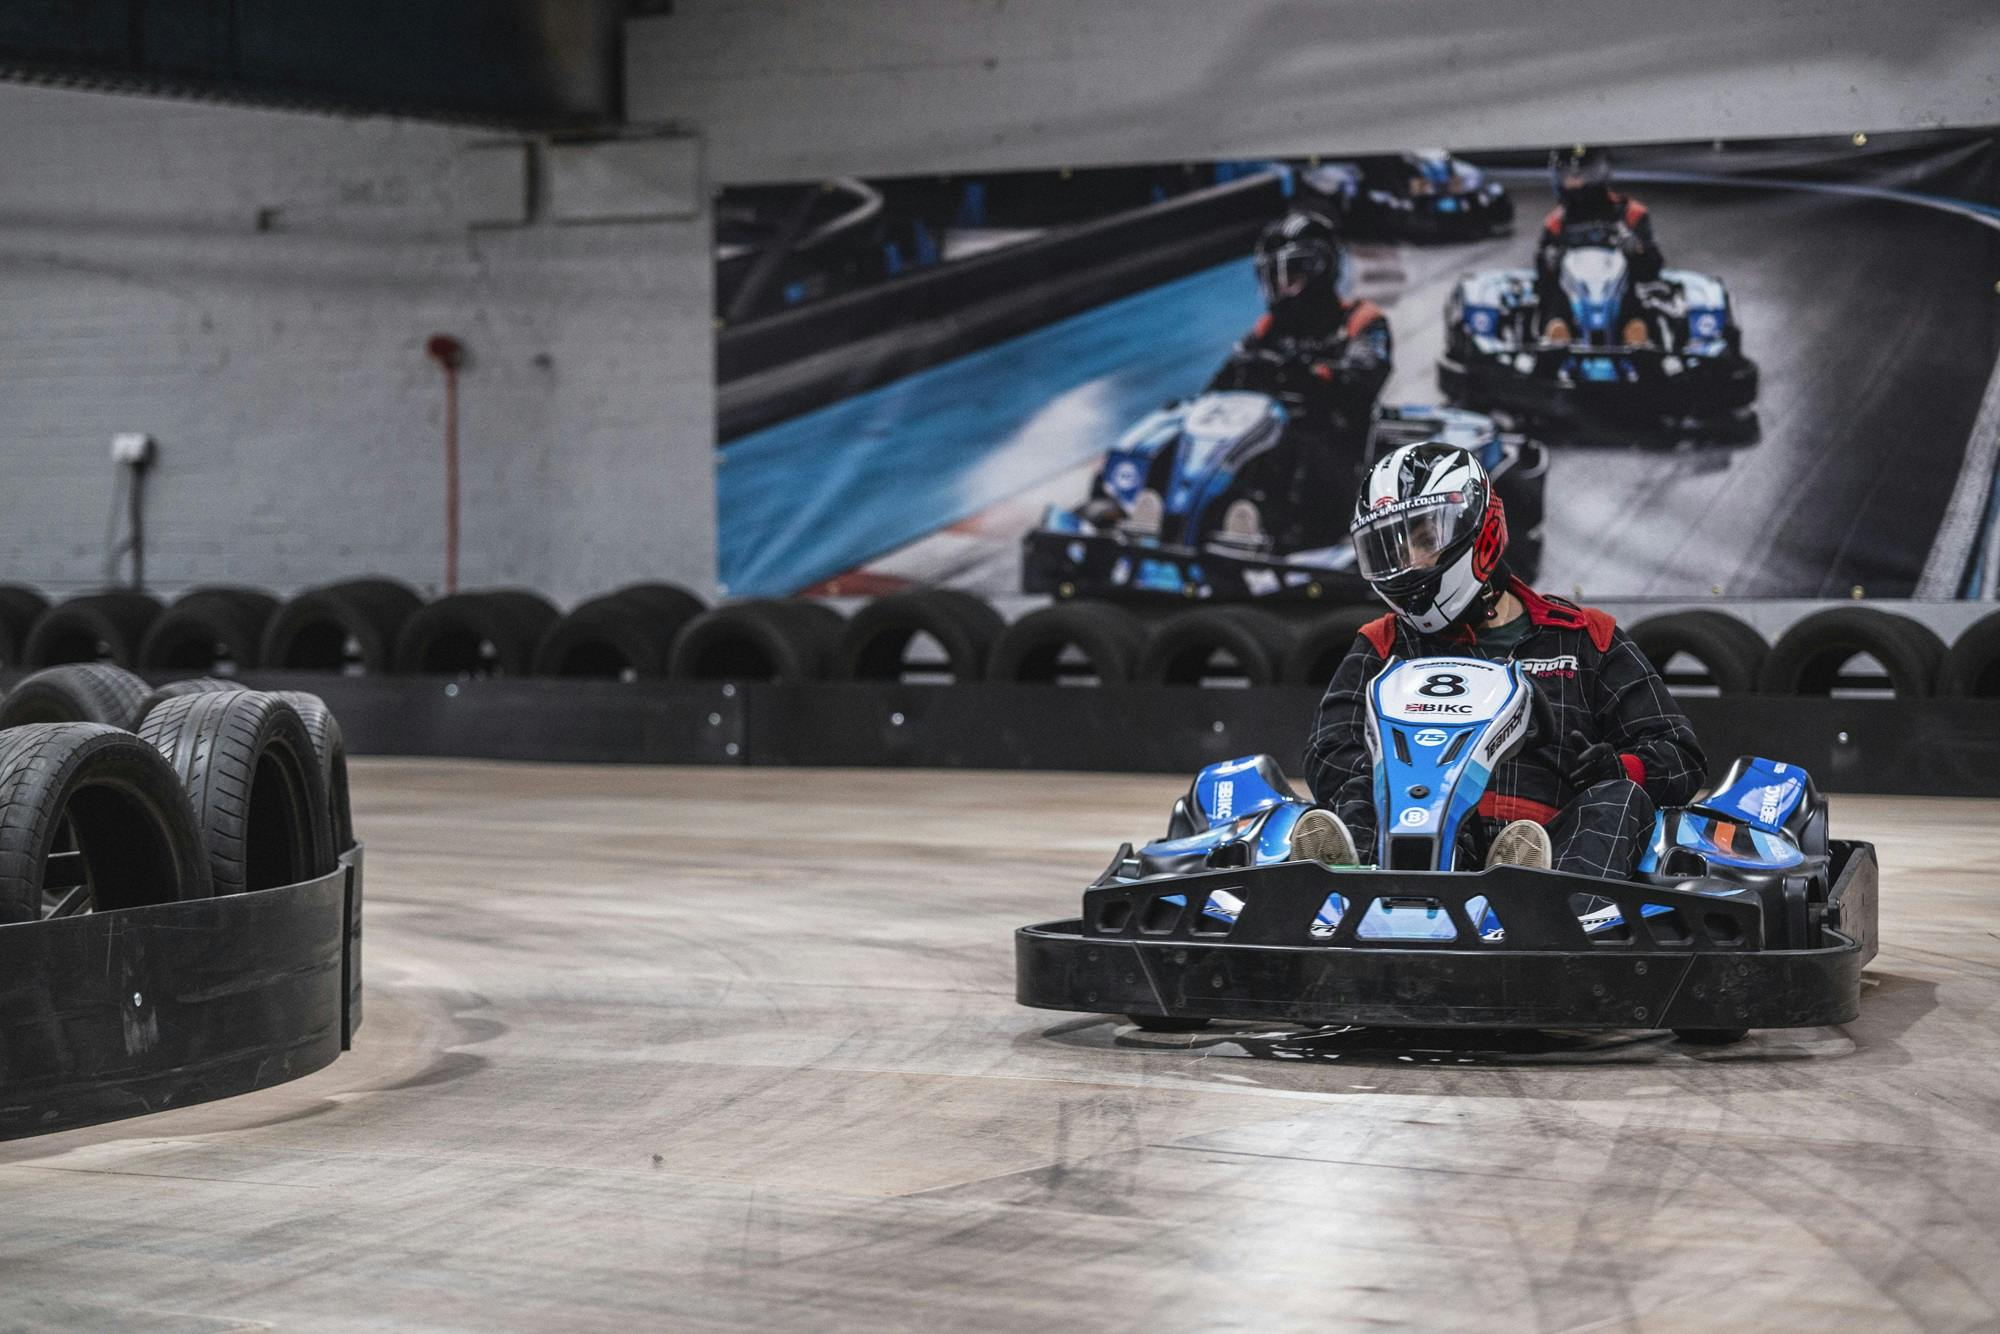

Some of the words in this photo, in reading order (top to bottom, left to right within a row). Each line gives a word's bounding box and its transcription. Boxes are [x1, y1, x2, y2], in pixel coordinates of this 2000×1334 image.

[1351, 493, 1446, 531] .TEAM-SPORT.CO.UK
[1418, 673, 1467, 698] 8
[1424, 703, 1473, 714] BIKC
